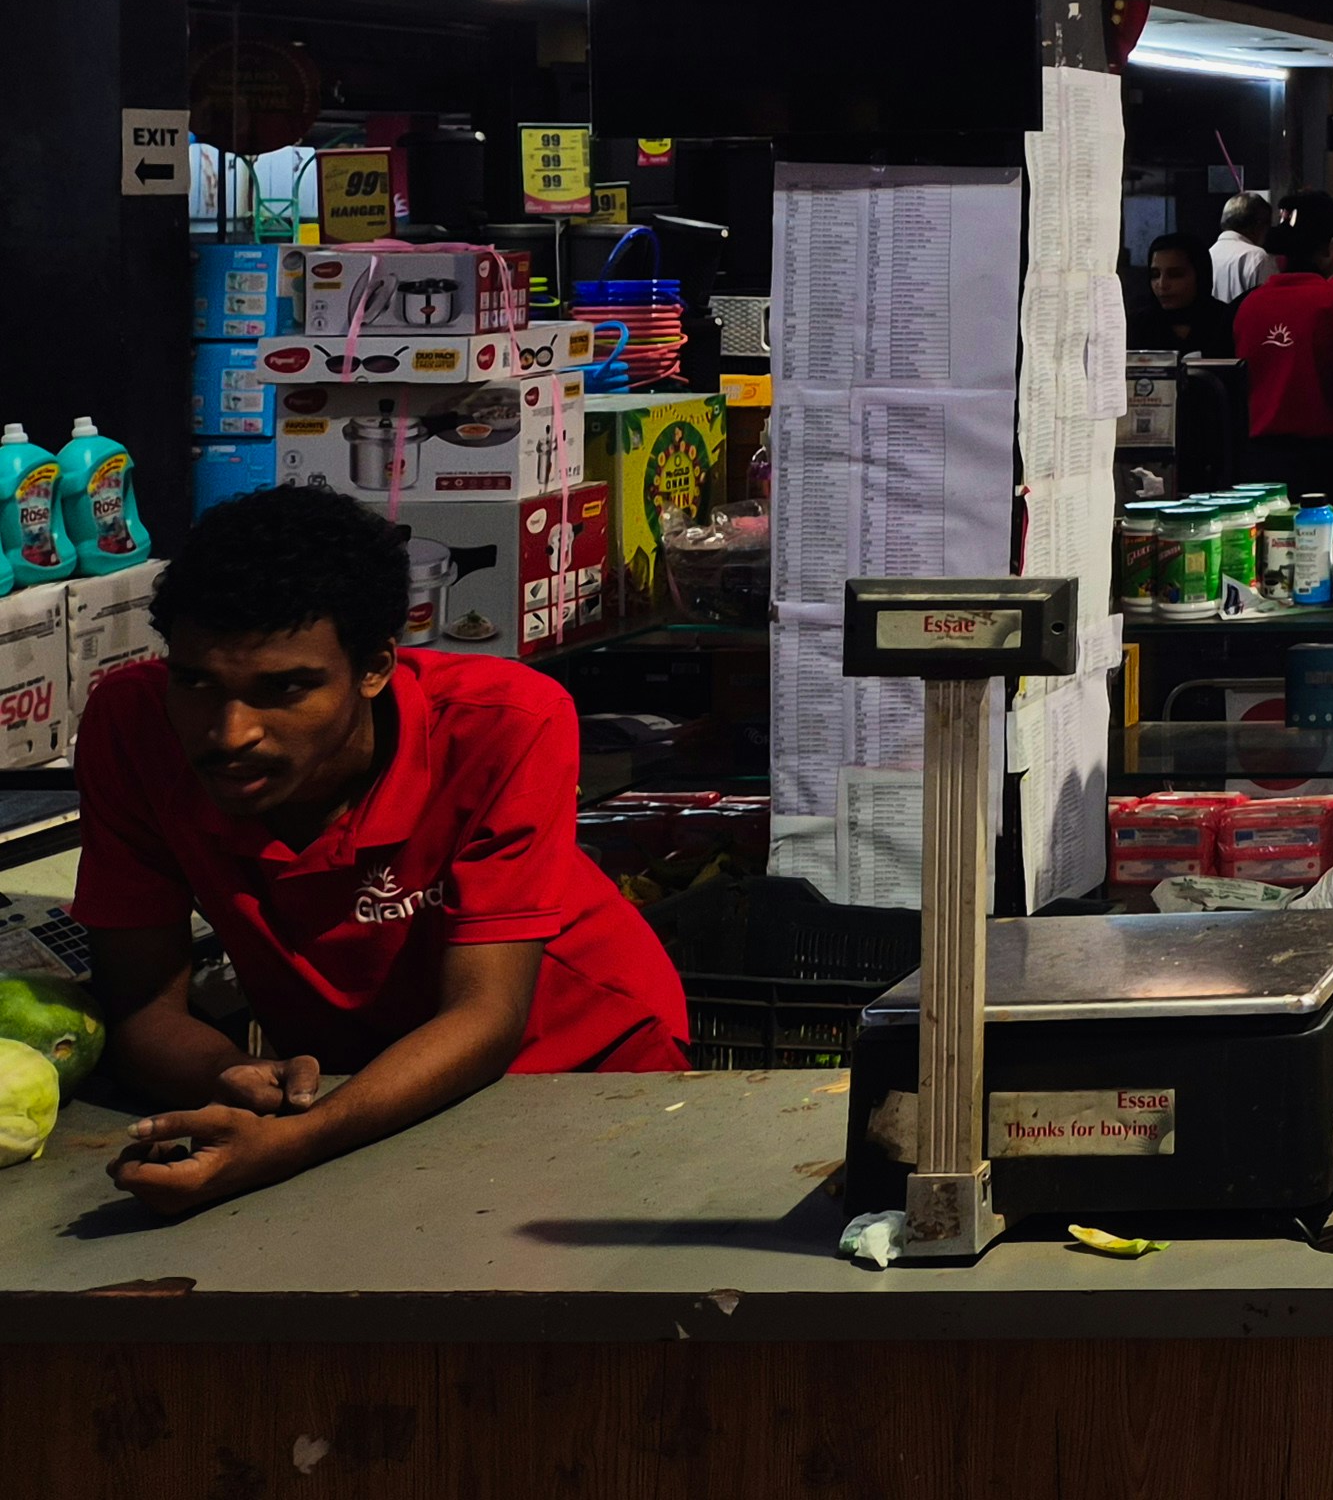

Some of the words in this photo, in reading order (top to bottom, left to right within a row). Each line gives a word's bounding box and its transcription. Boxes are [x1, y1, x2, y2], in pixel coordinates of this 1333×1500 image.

[133, 127, 179, 147] EXIT
[541, 133, 561, 147] 99
[541, 154, 561, 168] 99
[345, 171, 380, 197] 99
[541, 174, 562, 188] 99
[330, 204, 386, 218] HANGER
[415, 352, 432, 360] DUO
[433, 351, 456, 360] PACK
[285, 421, 325, 430] FAVOURITE
[20, 507, 50, 524] Rose
[93, 496, 122, 517] Rose
[923, 615, 976, 633] Essae
[0, 681, 53, 727] ROS
[354, 879, 445, 925] Grand
[1116, 1091, 1169, 1109] Essae
[1005, 1120, 1065, 1138] Thanks
[1070, 1120, 1095, 1137] for
[1100, 1120, 1159, 1141] buying
